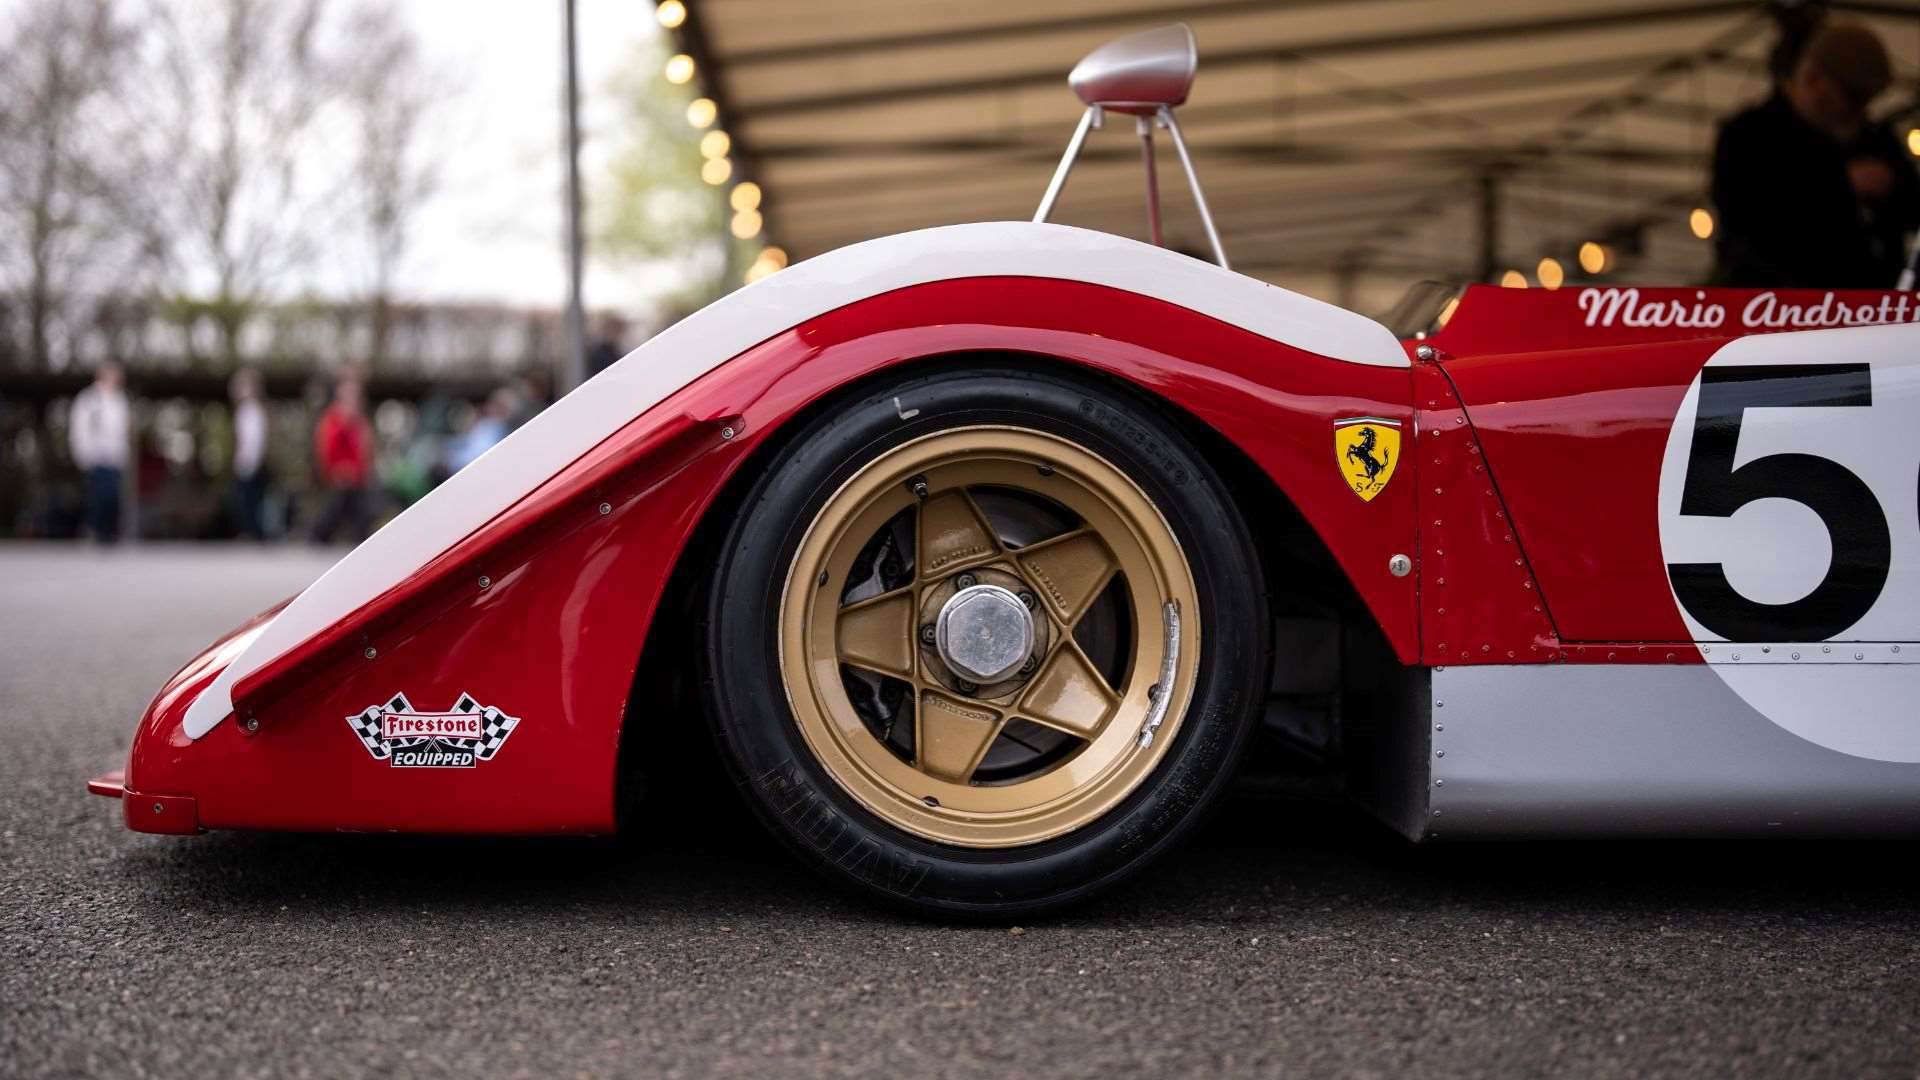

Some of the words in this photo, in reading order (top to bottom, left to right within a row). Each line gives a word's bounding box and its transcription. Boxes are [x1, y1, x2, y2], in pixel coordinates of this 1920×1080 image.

[1578, 288, 1725, 327] Mario
[1667, 363, 1920, 643] 5
[386, 716, 478, 735] Firestone
[394, 752, 473, 766] EQUIPPED
